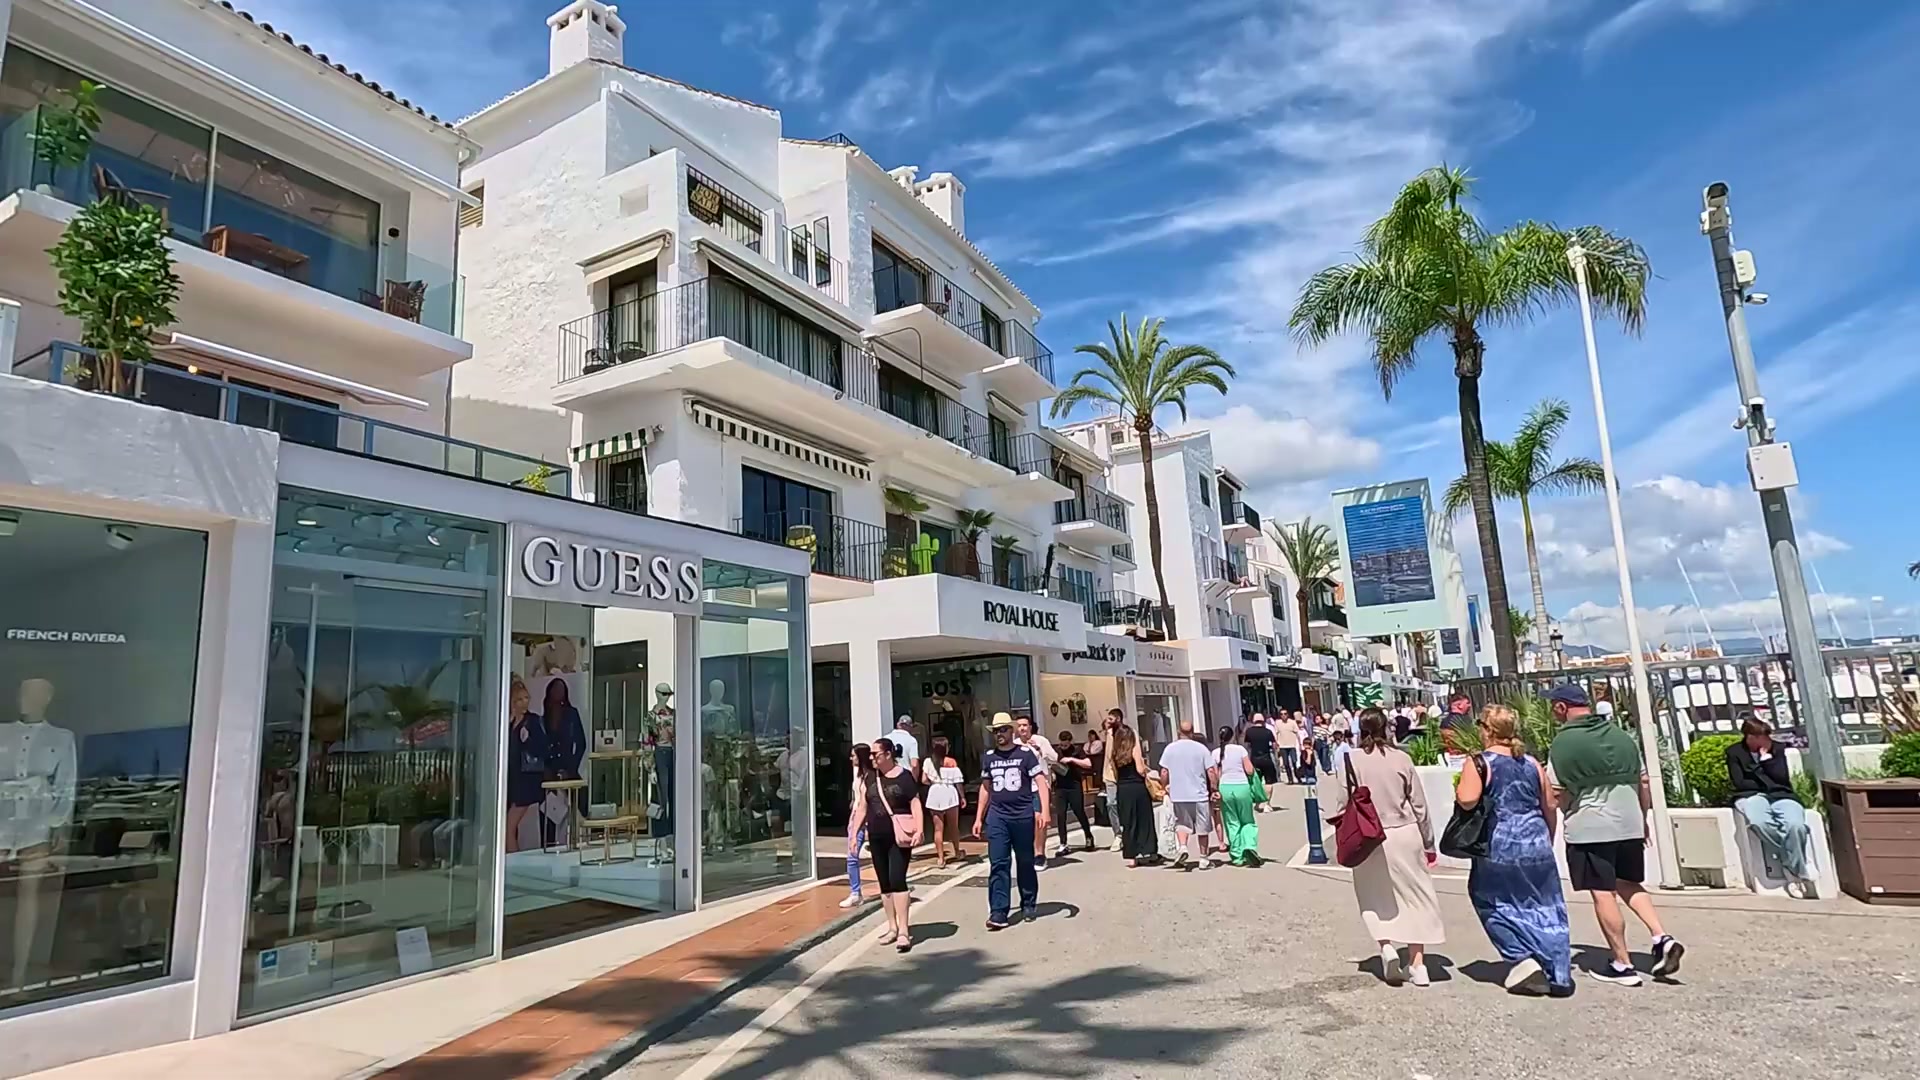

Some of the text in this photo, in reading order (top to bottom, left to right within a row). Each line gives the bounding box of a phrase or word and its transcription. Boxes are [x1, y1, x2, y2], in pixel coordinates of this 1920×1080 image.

[522, 536, 700, 604] GUESS
[6, 628, 126, 643] FRENCH RIVIERA
